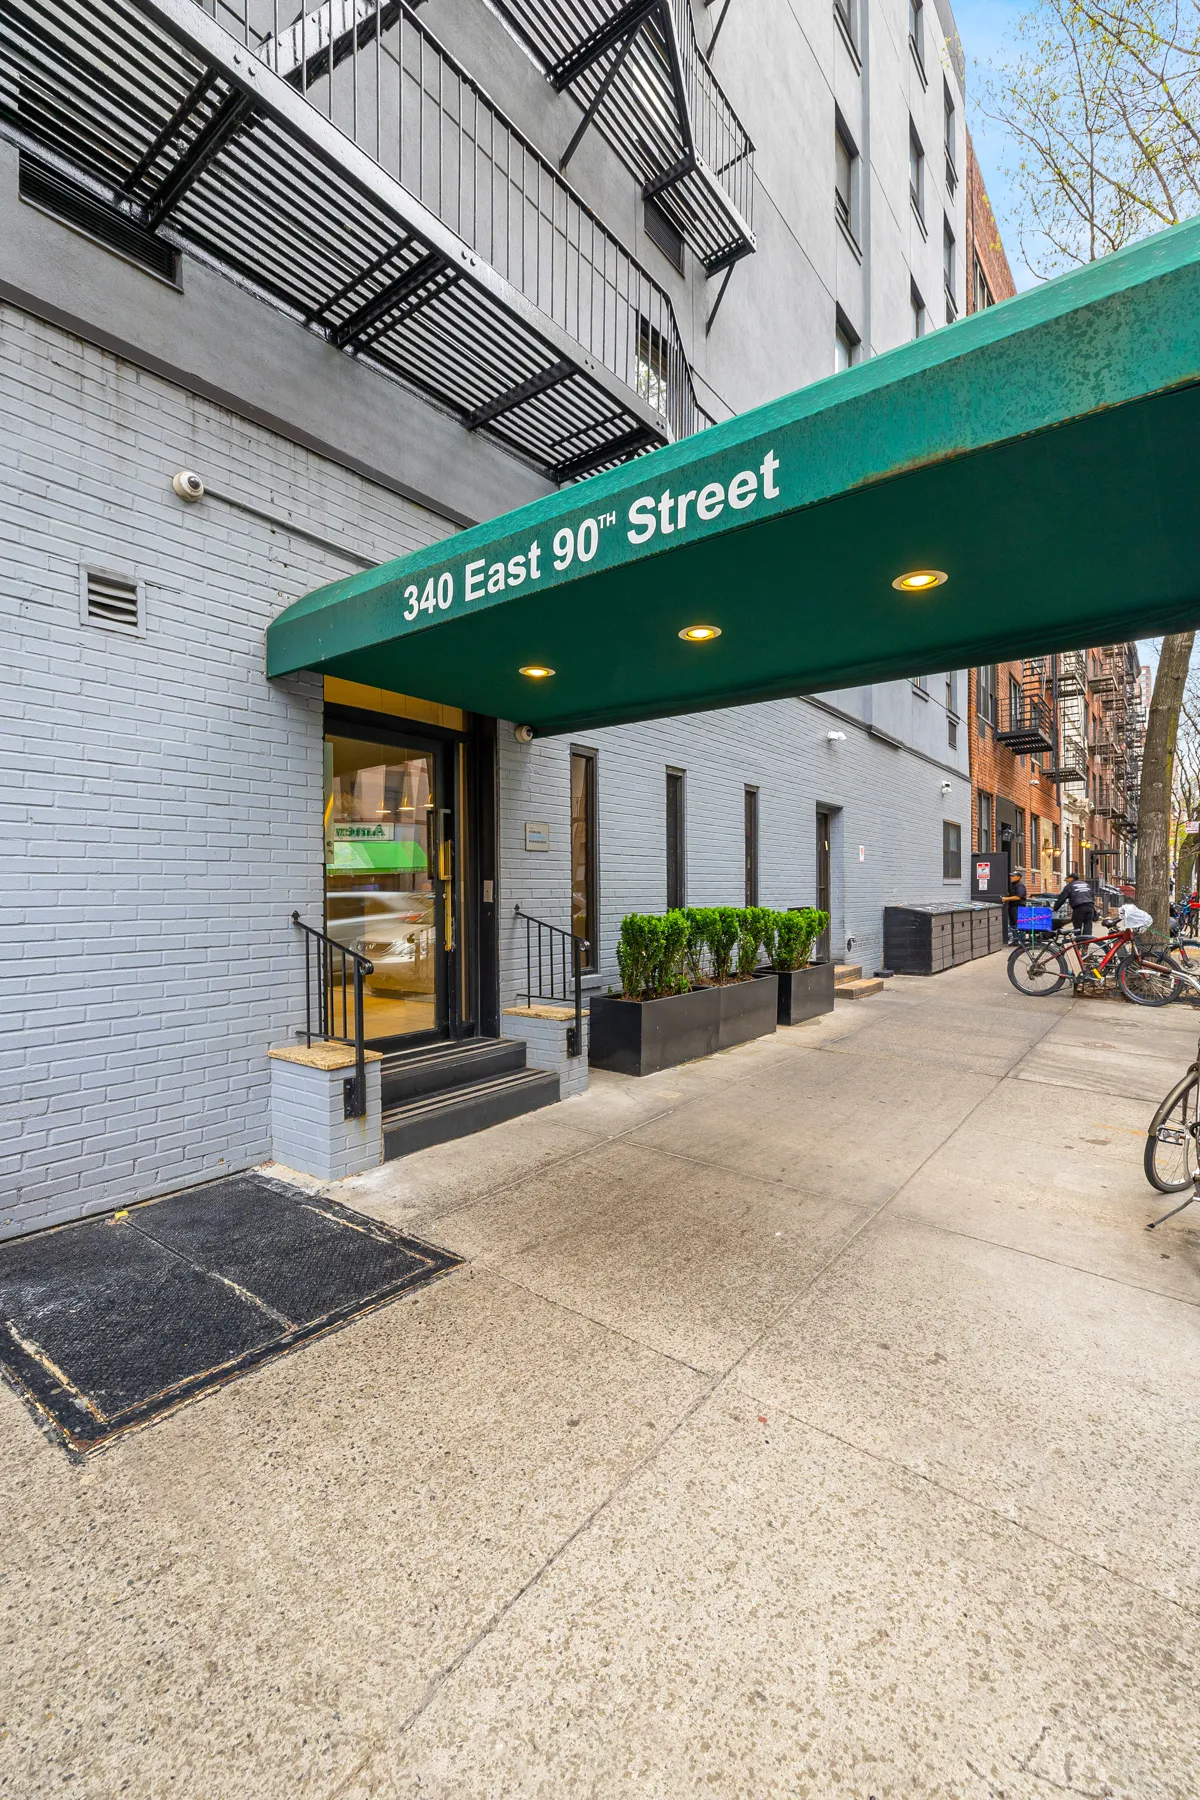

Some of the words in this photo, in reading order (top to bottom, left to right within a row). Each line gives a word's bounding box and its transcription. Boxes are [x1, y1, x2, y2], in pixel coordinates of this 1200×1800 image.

[403, 572, 454, 621] 340
[465, 540, 541, 602] East
[627, 449, 780, 545] Street
